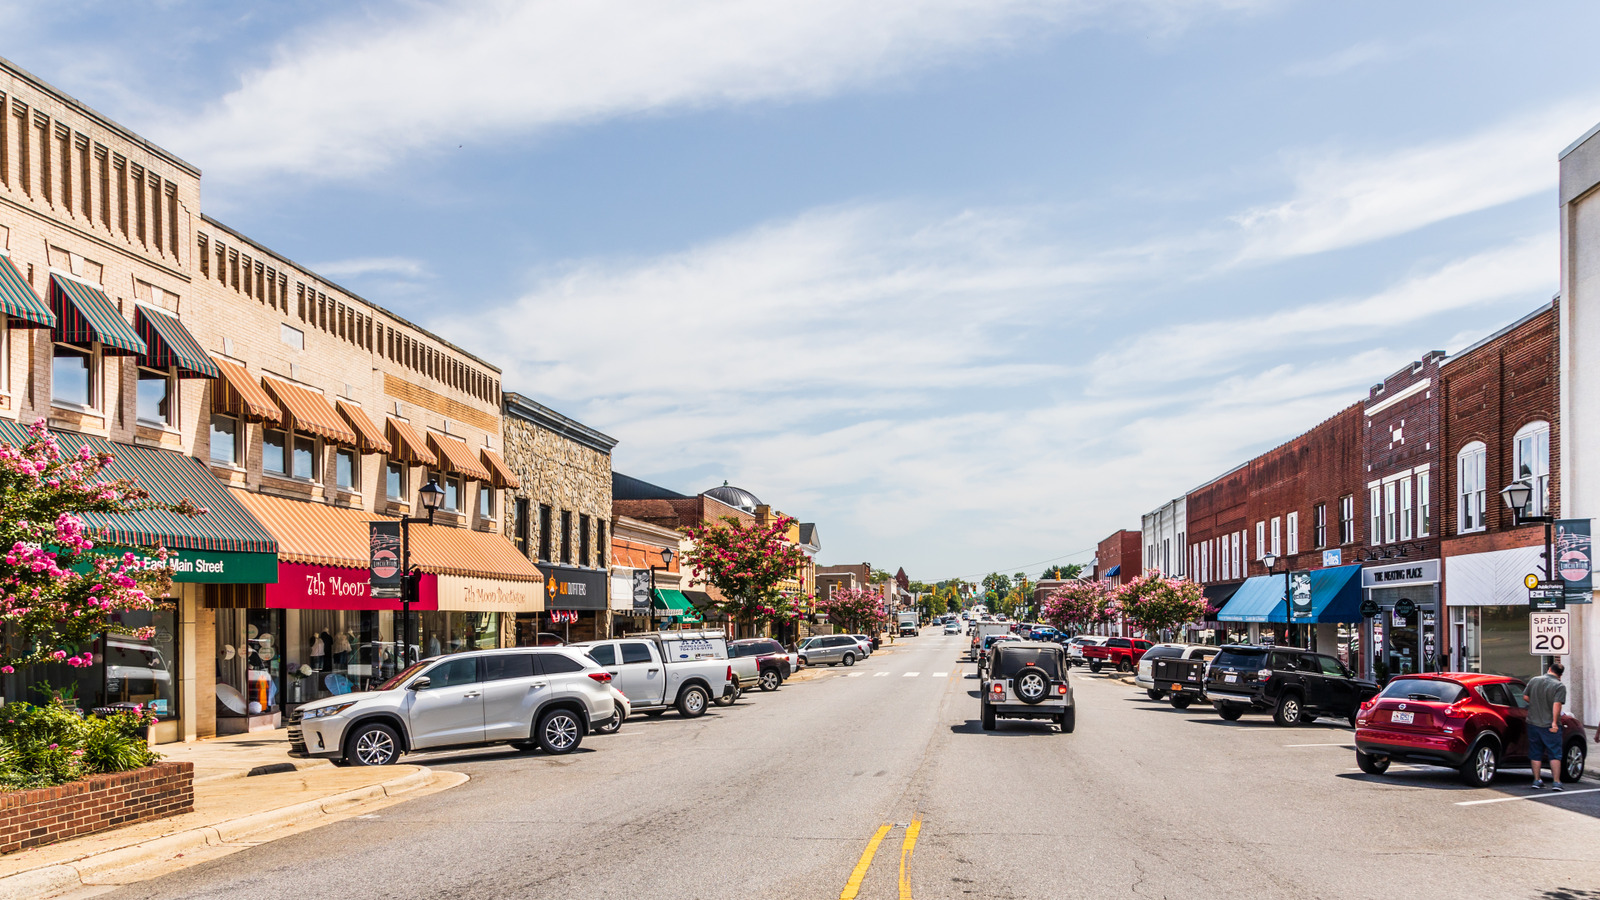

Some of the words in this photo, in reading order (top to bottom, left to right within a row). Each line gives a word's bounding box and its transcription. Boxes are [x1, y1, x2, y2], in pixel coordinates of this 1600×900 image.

[143, 556, 167, 571] East
[169, 558, 193, 572] Main
[195, 559, 224, 573] Street
[1374, 572, 1383, 582] THE
[1406, 567, 1423, 579] PLACE
[1528, 576, 1536, 587] P
[306, 573, 326, 596] 7th
[329, 576, 365, 597] Moon
[464, 585, 476, 602] 7th
[476, 588, 497, 603] Moon
[497, 587, 526, 606] Boutique
[1535, 634, 1565, 650] 20
